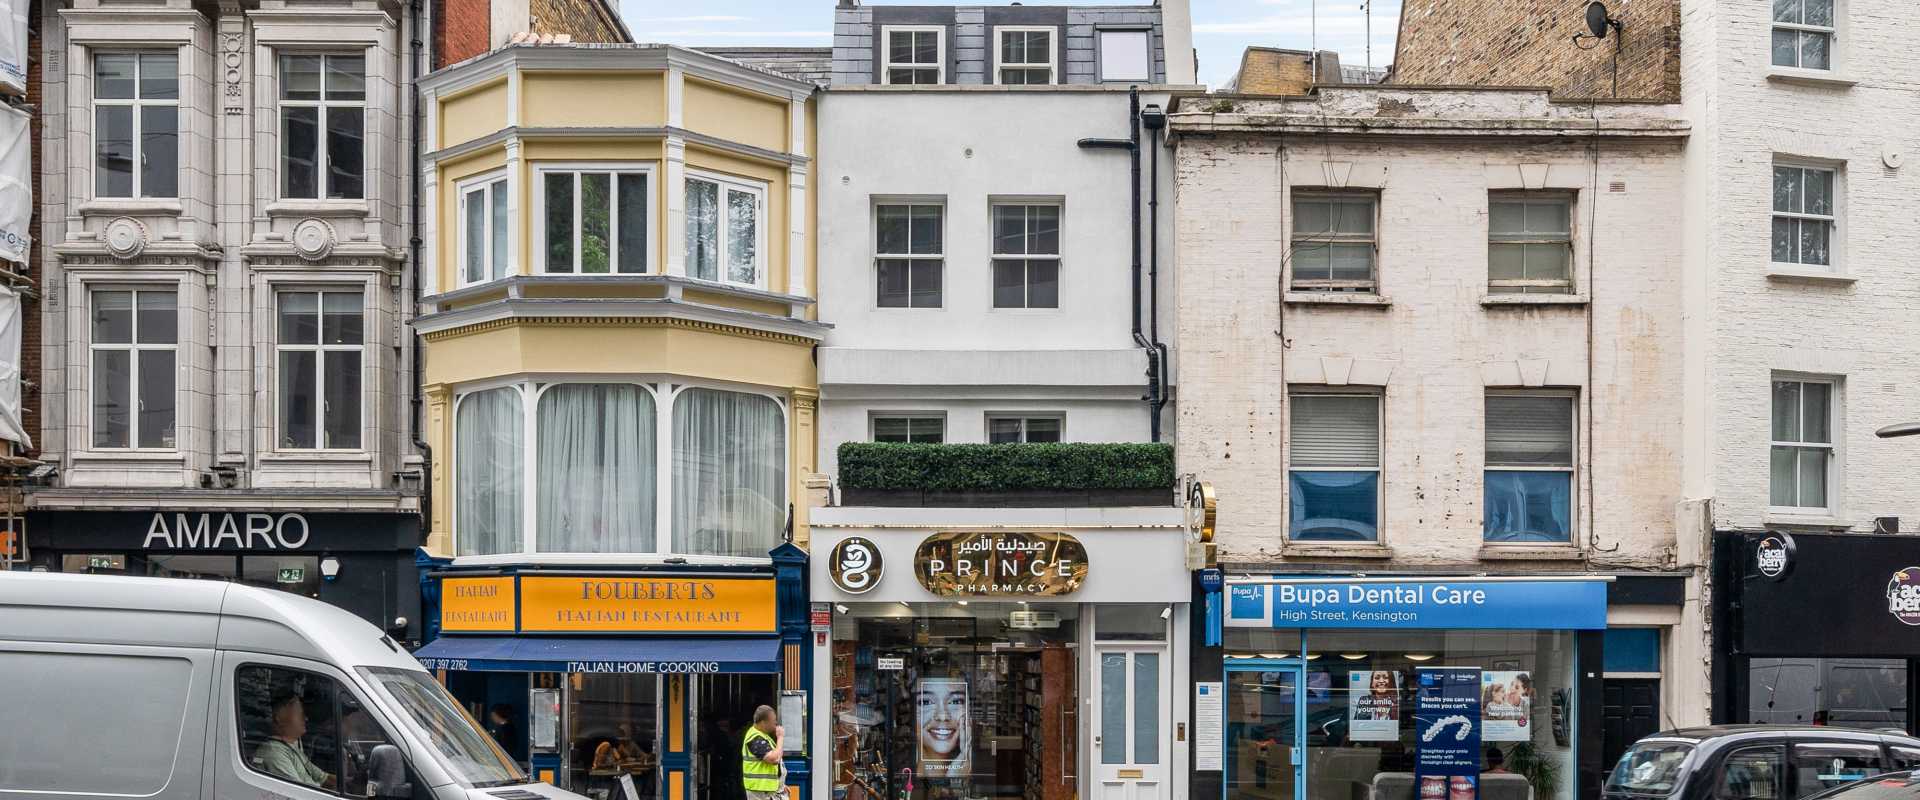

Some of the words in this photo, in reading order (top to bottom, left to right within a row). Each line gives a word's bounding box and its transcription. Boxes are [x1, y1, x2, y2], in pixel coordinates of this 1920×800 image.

[142, 512, 309, 549] AMARO
[957, 534, 992, 554] الأمير
[996, 534, 1046, 554] صيدلية
[931, 559, 1072, 577] PRINCE
[455, 585, 497, 597] ITALIAN
[957, 584, 1047, 592] PHARMACY
[1232, 587, 1252, 596] Bupa
[1280, 585, 1340, 607] Bupa
[1348, 585, 1423, 604] Dental
[1432, 585, 1486, 604] Care
[445, 611, 508, 623] RESTAURANT
[556, 610, 626, 623] ITALIAN
[632, 610, 742, 623] RESTAURANT
[1280, 610, 1307, 622] High
[1311, 610, 1349, 621] Street,
[1352, 610, 1417, 623] Kensington
[437, 659, 450, 669] 397
[451, 659, 469, 670] 2762
[567, 662, 614, 673] ITALIAN
[617, 662, 656, 673] HOME
[658, 661, 719, 673] COOKING
